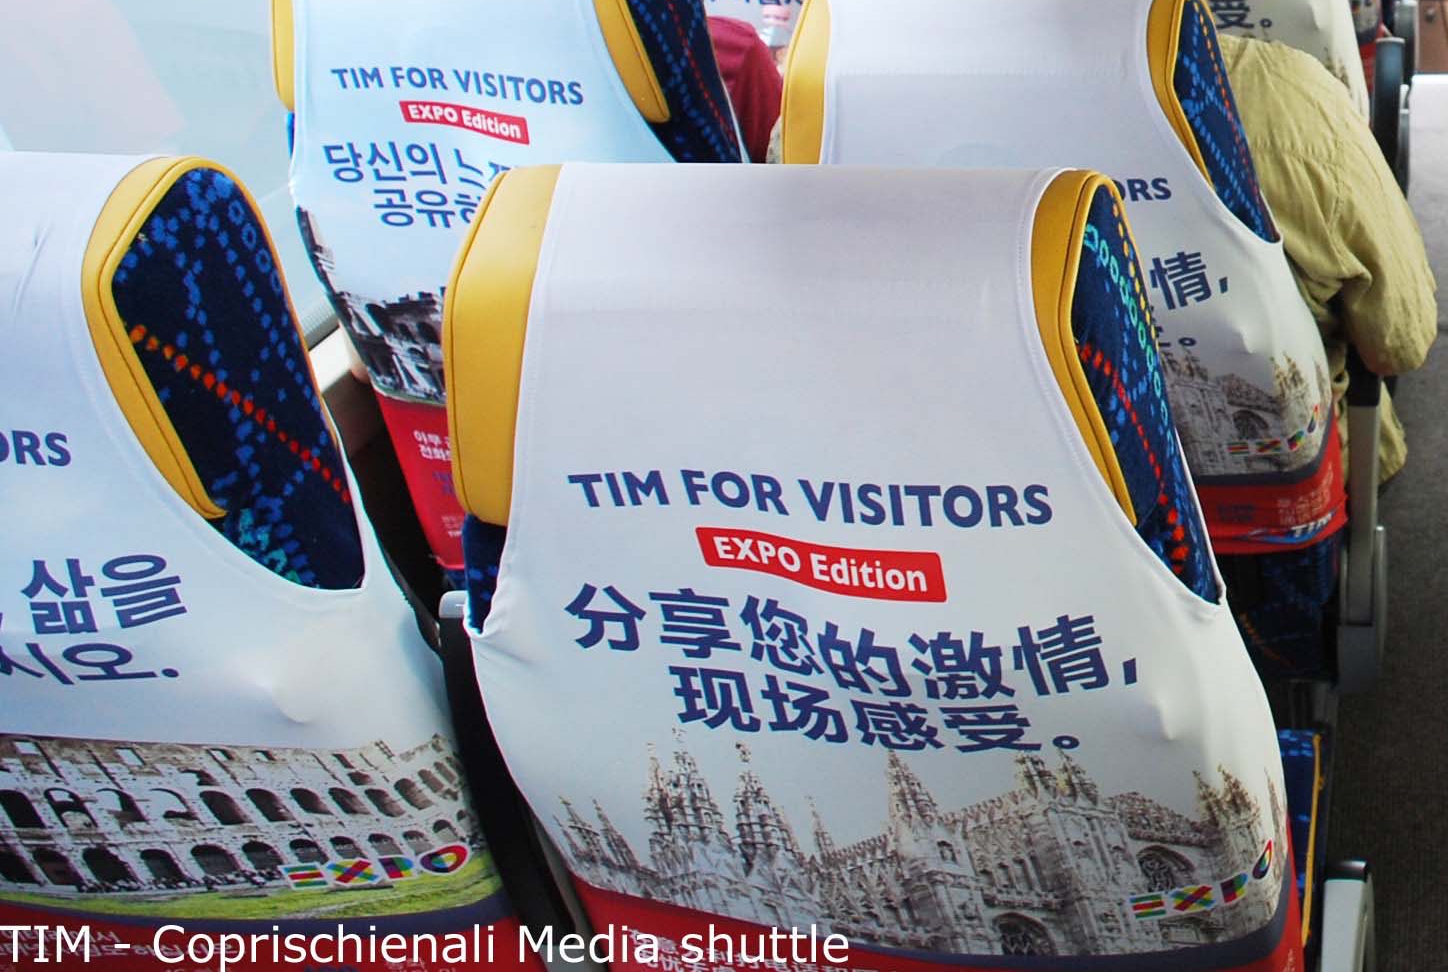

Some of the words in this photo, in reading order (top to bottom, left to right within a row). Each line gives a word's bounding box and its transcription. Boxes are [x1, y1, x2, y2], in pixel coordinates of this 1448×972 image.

[331, 67, 385, 90] TIM
[390, 66, 448, 91] FOR
[453, 69, 585, 106] VISITORS
[406, 104, 458, 123] EXPO
[461, 109, 522, 140] Edition
[322, 141, 449, 185] 당신의
[566, 469, 670, 509] TIM
[679, 468, 791, 516] FOR
[797, 477, 1053, 529] VISITORS
[711, 534, 801, 573] EXPO
[809, 552, 929, 593] Edition
[20, 554, 188, 636] 삶을
[564, 582, 1138, 701] 分享您的激情，
[667, 664, 1082, 754] 现场感受。
[276, 842, 473, 891] EXPO
